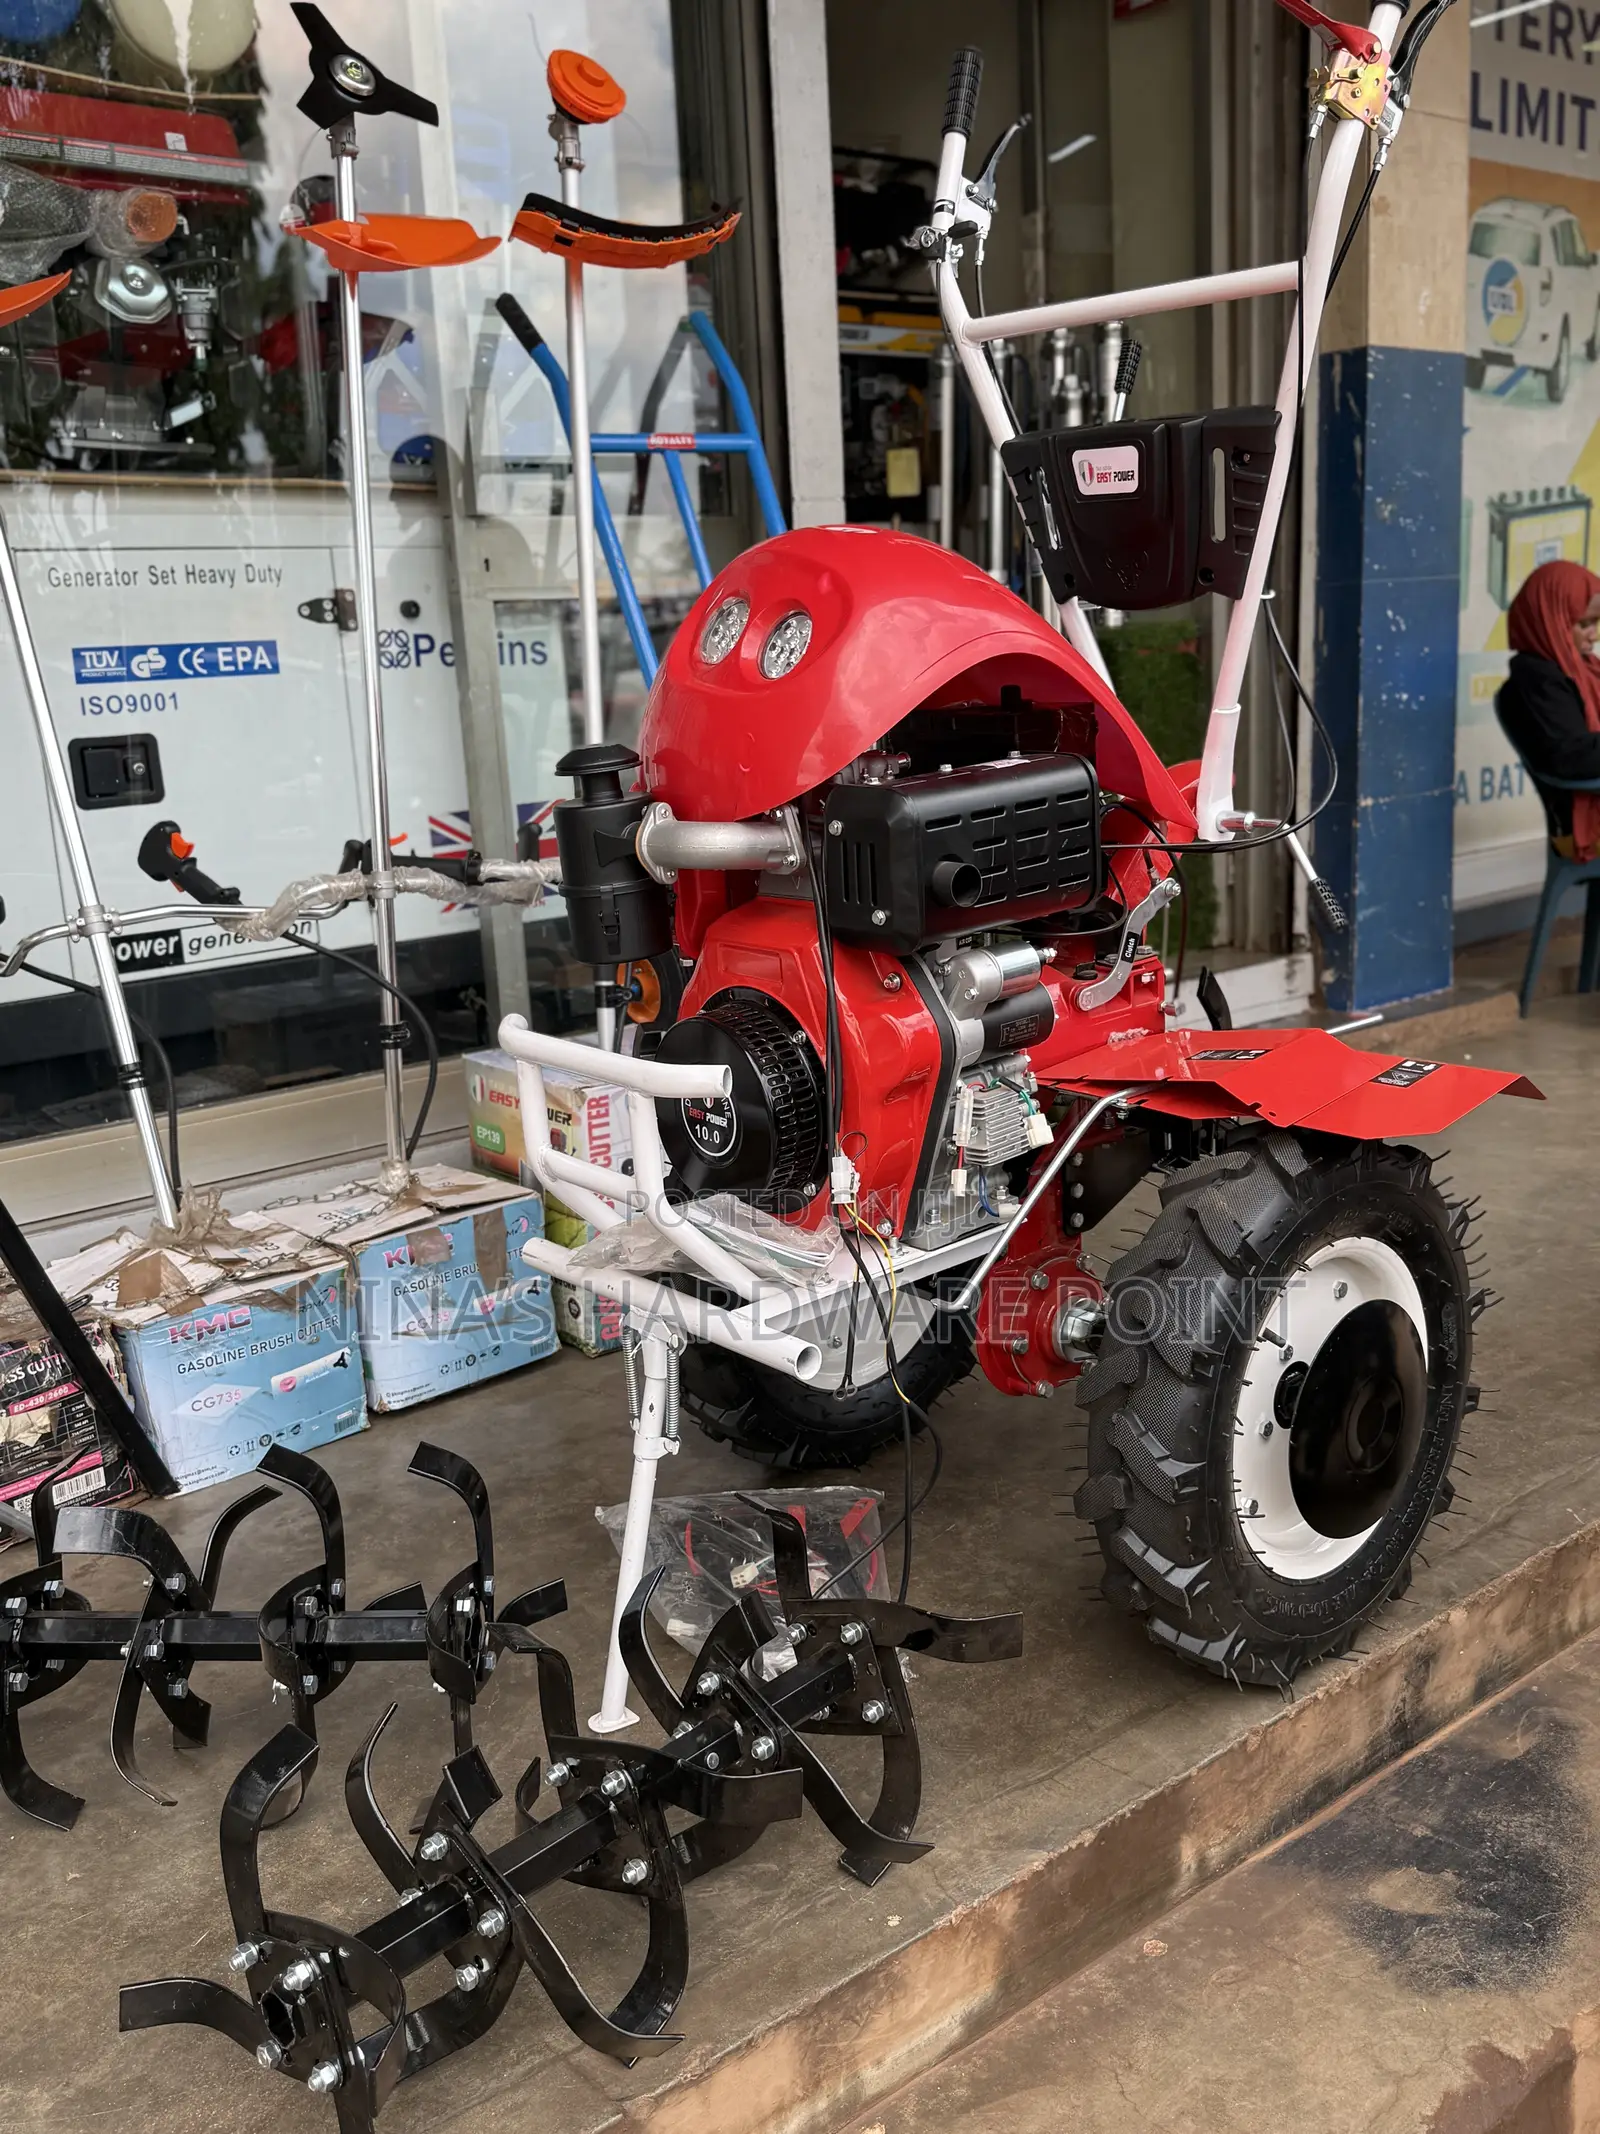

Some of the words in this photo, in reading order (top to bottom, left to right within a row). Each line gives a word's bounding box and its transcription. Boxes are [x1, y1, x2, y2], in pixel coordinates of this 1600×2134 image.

[1495, 0, 1600, 65] TERY
[1471, 71, 1596, 151] LIMIT
[1096, 472, 1112, 483] EASY
[1113, 470, 1135, 483] POWER
[48, 566, 139, 588] Generator
[148, 565, 177, 585] Set
[184, 564, 236, 588] Heavy
[244, 563, 283, 588] Duty
[217, 646, 273, 672] EPA
[413, 632, 548, 668] Peins
[80, 692, 179, 716] ISO9001
[112, 933, 180, 962] ower
[188, 920, 312, 955] geneon
[489, 1090, 520, 1109] EASY
[688, 1107, 705, 1120] EASY
[705, 1112, 728, 1128] POWER
[476, 1126, 501, 1145] EP139
[587, 1094, 612, 1168] CUTTER
[695, 1124, 720, 1144] 10.0
[393, 1271, 451, 1297] GASOLINE
[168, 1307, 251, 1344] KMC
[177, 1347, 247, 1375] GASOLINE
[250, 1333, 294, 1355] BRUSH
[297, 1314, 340, 1340] CUTTER
[191, 1389, 242, 1412] CG735
